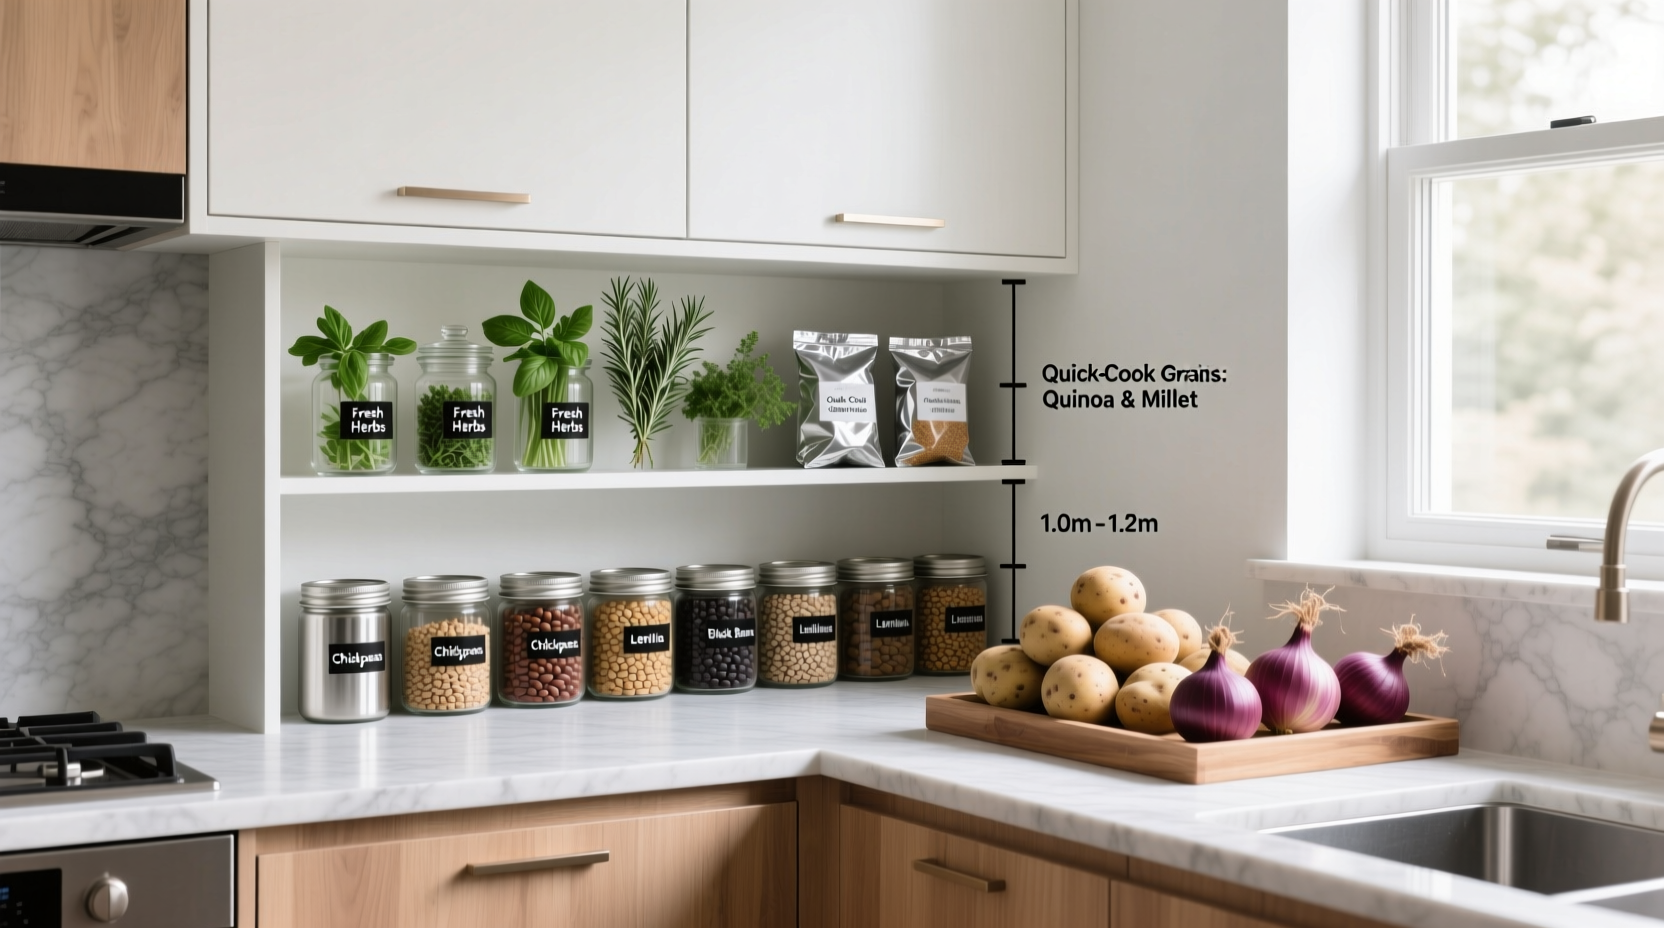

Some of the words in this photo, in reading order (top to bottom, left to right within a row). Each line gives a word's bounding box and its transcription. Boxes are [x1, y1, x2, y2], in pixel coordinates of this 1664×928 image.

[352, 405, 384, 419] Fresh
[453, 404, 485, 419] Fresh
[351, 419, 386, 434] Herbs
[452, 419, 486, 433] Herbs
[551, 419, 584, 433] Herbs
